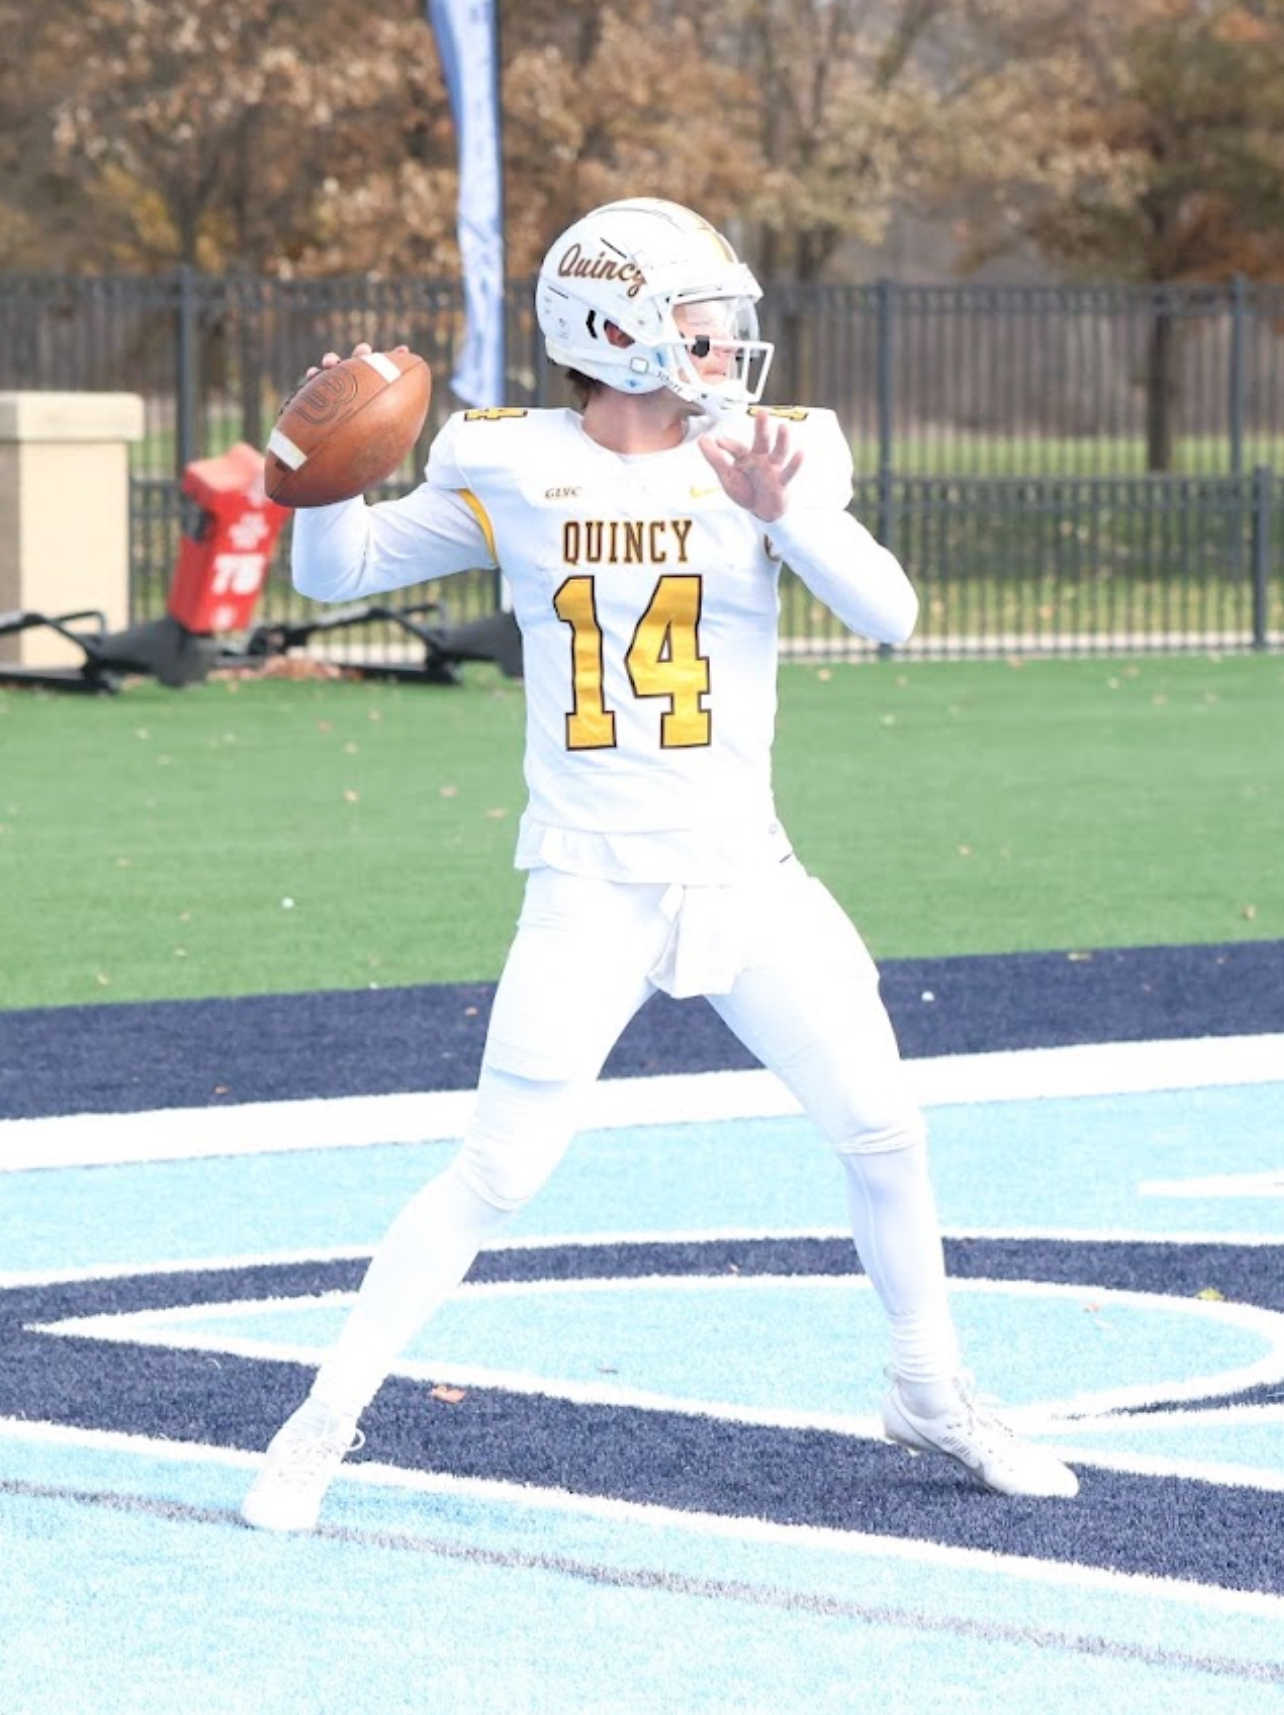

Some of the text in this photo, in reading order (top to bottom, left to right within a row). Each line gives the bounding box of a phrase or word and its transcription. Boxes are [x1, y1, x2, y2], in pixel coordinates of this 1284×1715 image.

[558, 243, 647, 297] Quincy
[545, 486, 582, 500] GLVC
[563, 520, 693, 565] QUINCY
[552, 573, 712, 751] 14
